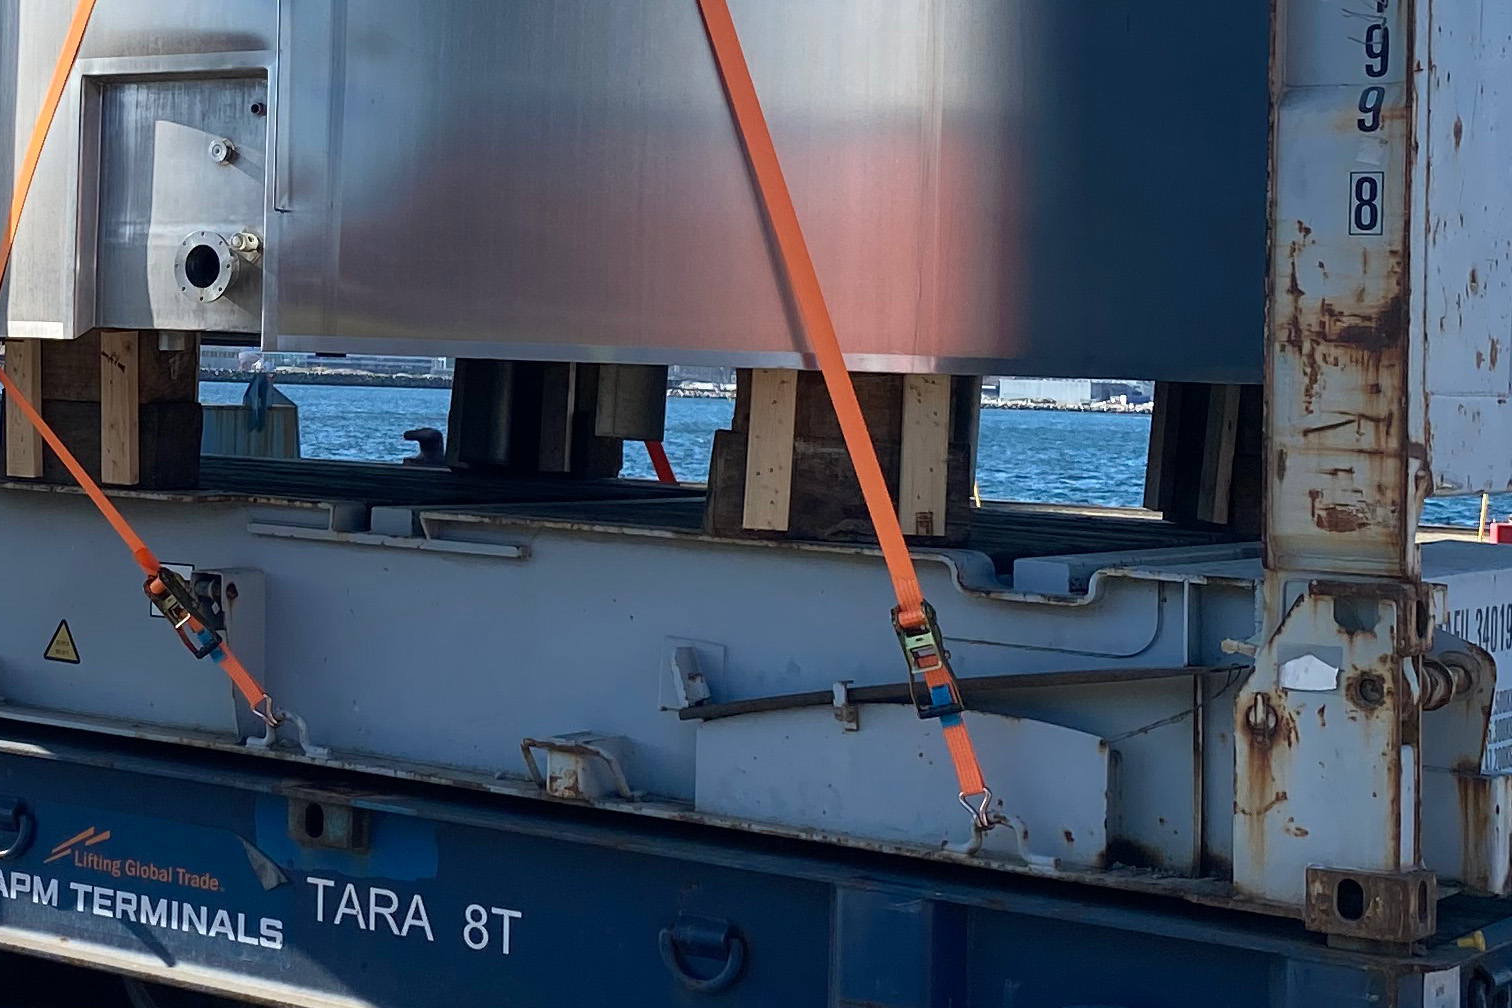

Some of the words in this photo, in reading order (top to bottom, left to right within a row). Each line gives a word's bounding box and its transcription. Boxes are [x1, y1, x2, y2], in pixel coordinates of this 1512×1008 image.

[74, 849, 121, 878] Lifting
[125, 859, 173, 883] Global
[69, 881, 284, 950] TERMINALS
[306, 876, 435, 942] TARA
[463, 903, 523, 955] 8T
